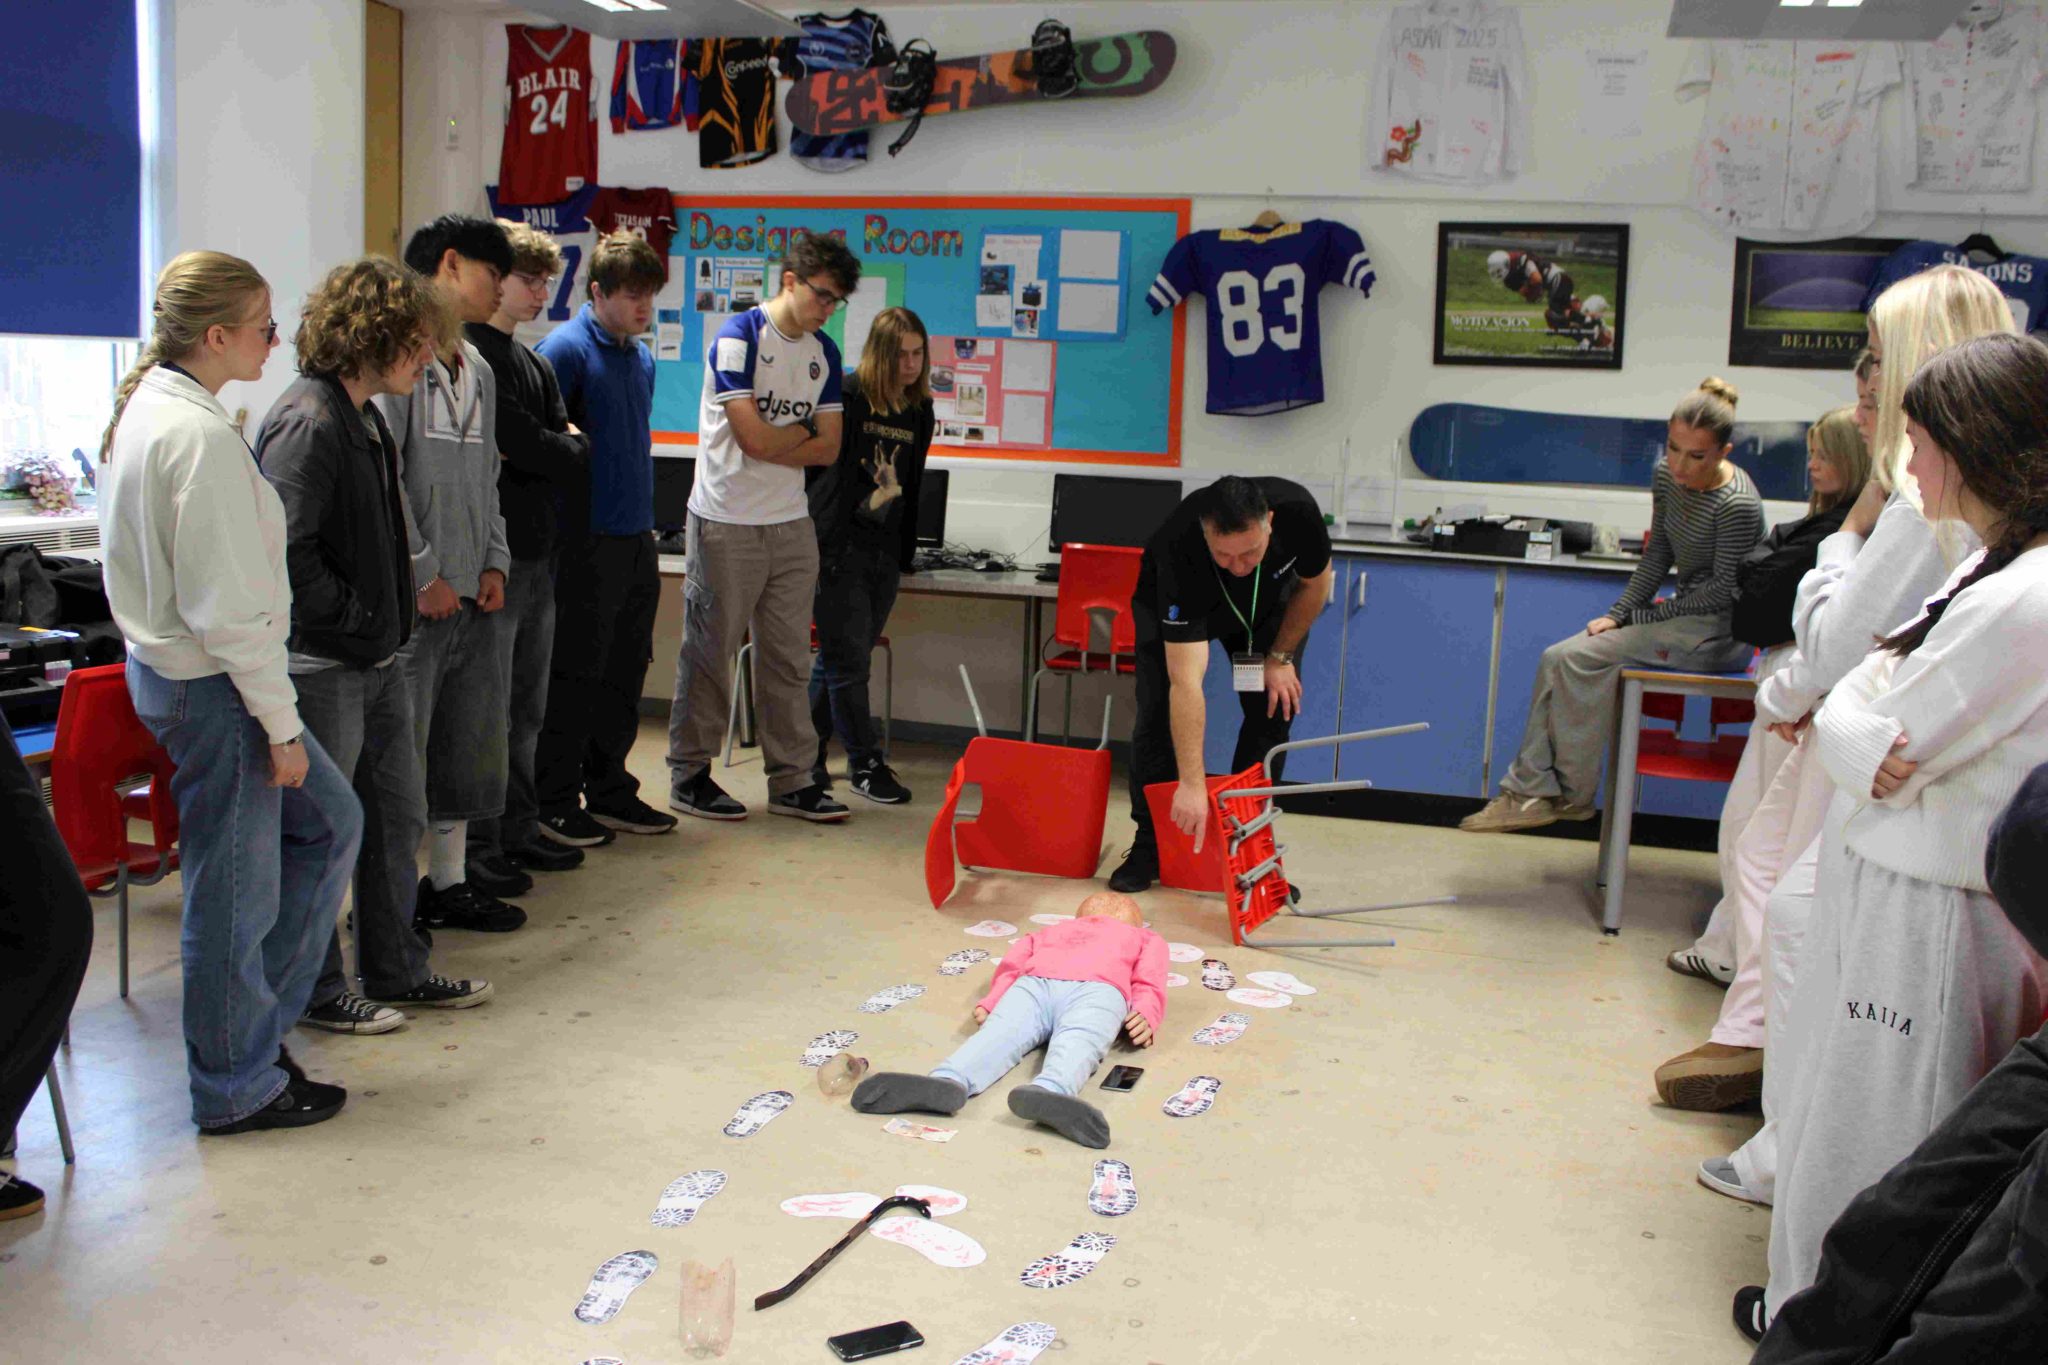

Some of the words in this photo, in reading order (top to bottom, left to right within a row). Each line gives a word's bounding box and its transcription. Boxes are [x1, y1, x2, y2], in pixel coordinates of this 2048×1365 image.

[518, 67, 581, 98] BLAIR
[529, 89, 569, 135] 24
[522, 207, 560, 229] PAUL
[864, 213, 964, 257] Room
[1942, 250, 2033, 284] SAONS
[1216, 262, 1306, 358] 83
[1781, 333, 1860, 350] BELIEVE
[1847, 1001, 1912, 1036] KAIIA
